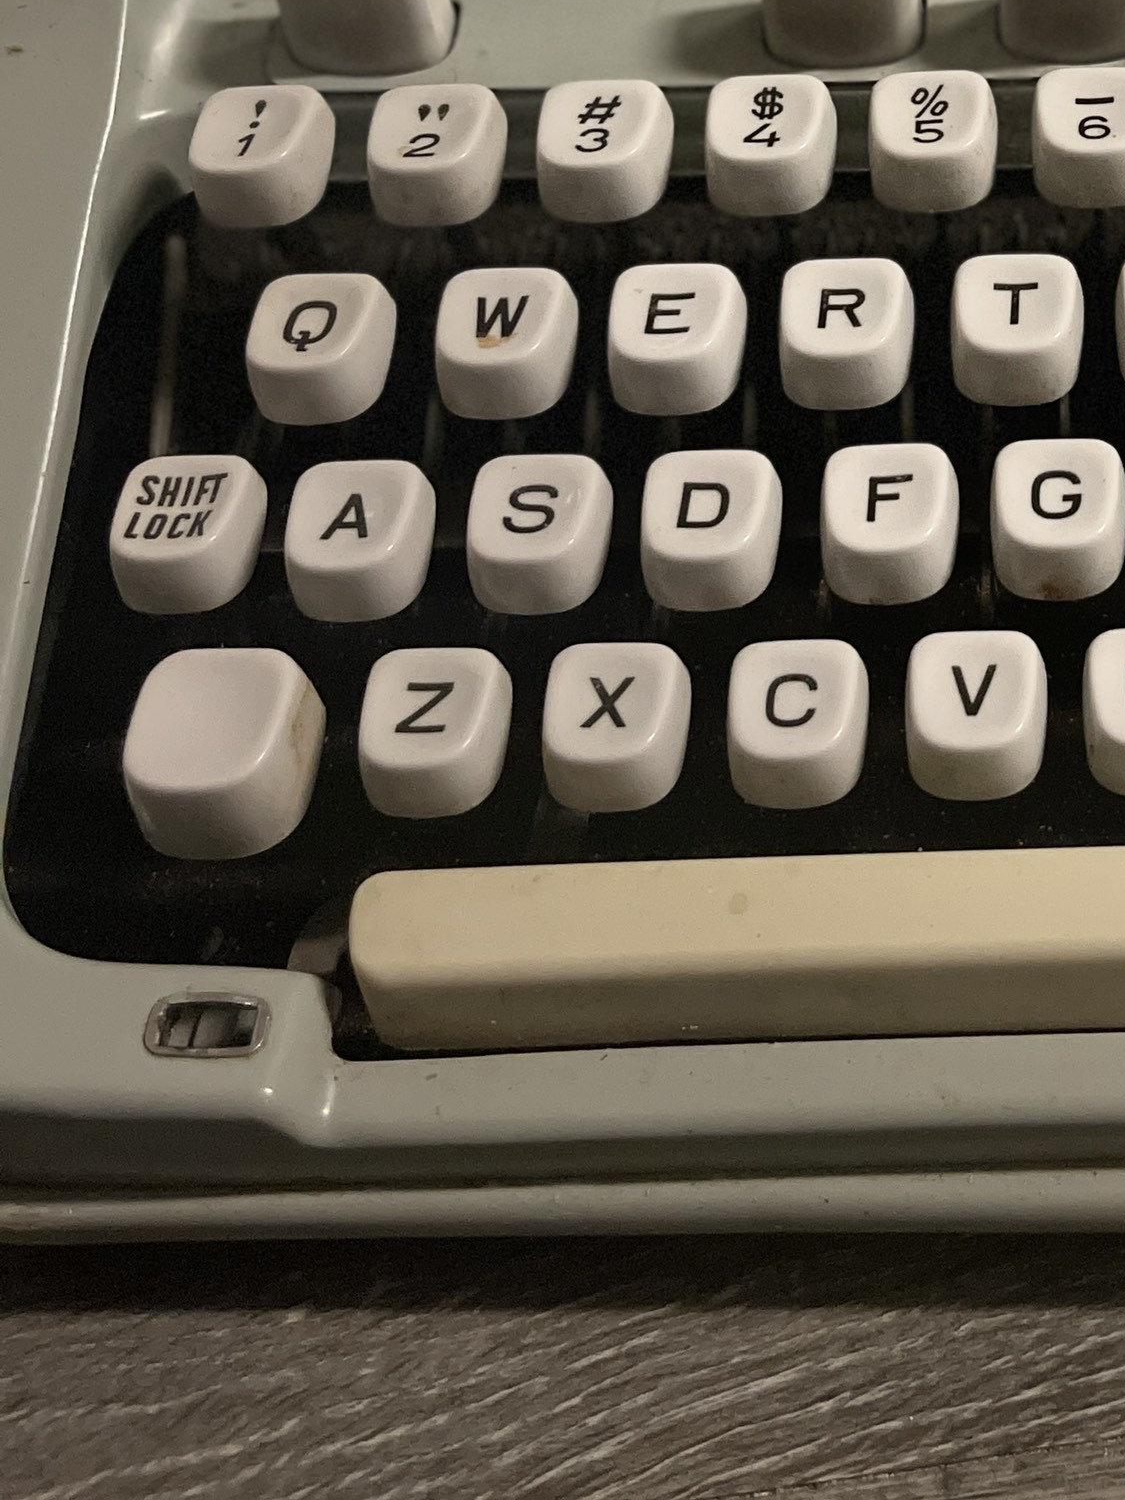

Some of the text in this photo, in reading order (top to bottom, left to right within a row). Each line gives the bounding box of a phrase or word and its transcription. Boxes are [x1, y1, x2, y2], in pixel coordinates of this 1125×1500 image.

[248, 99, 267, 129] !
[577, 95, 622, 125] #
[751, 86, 784, 121] $
[910, 84, 949, 119] %
[237, 133, 256, 157] 1
[402, 133, 441, 158] 2
[574, 128, 610, 153] 3
[742, 123, 781, 148] 4
[912, 118, 945, 144] 5
[1078, 115, 1111, 140] 6
[475, 295, 530, 339] W
[643, 292, 696, 335] E
[817, 288, 866, 329] R
[993, 282, 1039, 325] T
[282, 300, 338, 353] Q
[135, 472, 229, 508] SHIFT
[502, 484, 559, 534] S
[676, 481, 730, 529] D
[866, 473, 914, 523] F
[1030, 470, 1082, 520] G
[123, 509, 213, 540] LOCK
[319, 493, 369, 541] A
[394, 681, 455, 734] Z
[579, 676, 636, 729] X
[765, 673, 818, 728] C
[951, 664, 997, 717] V
